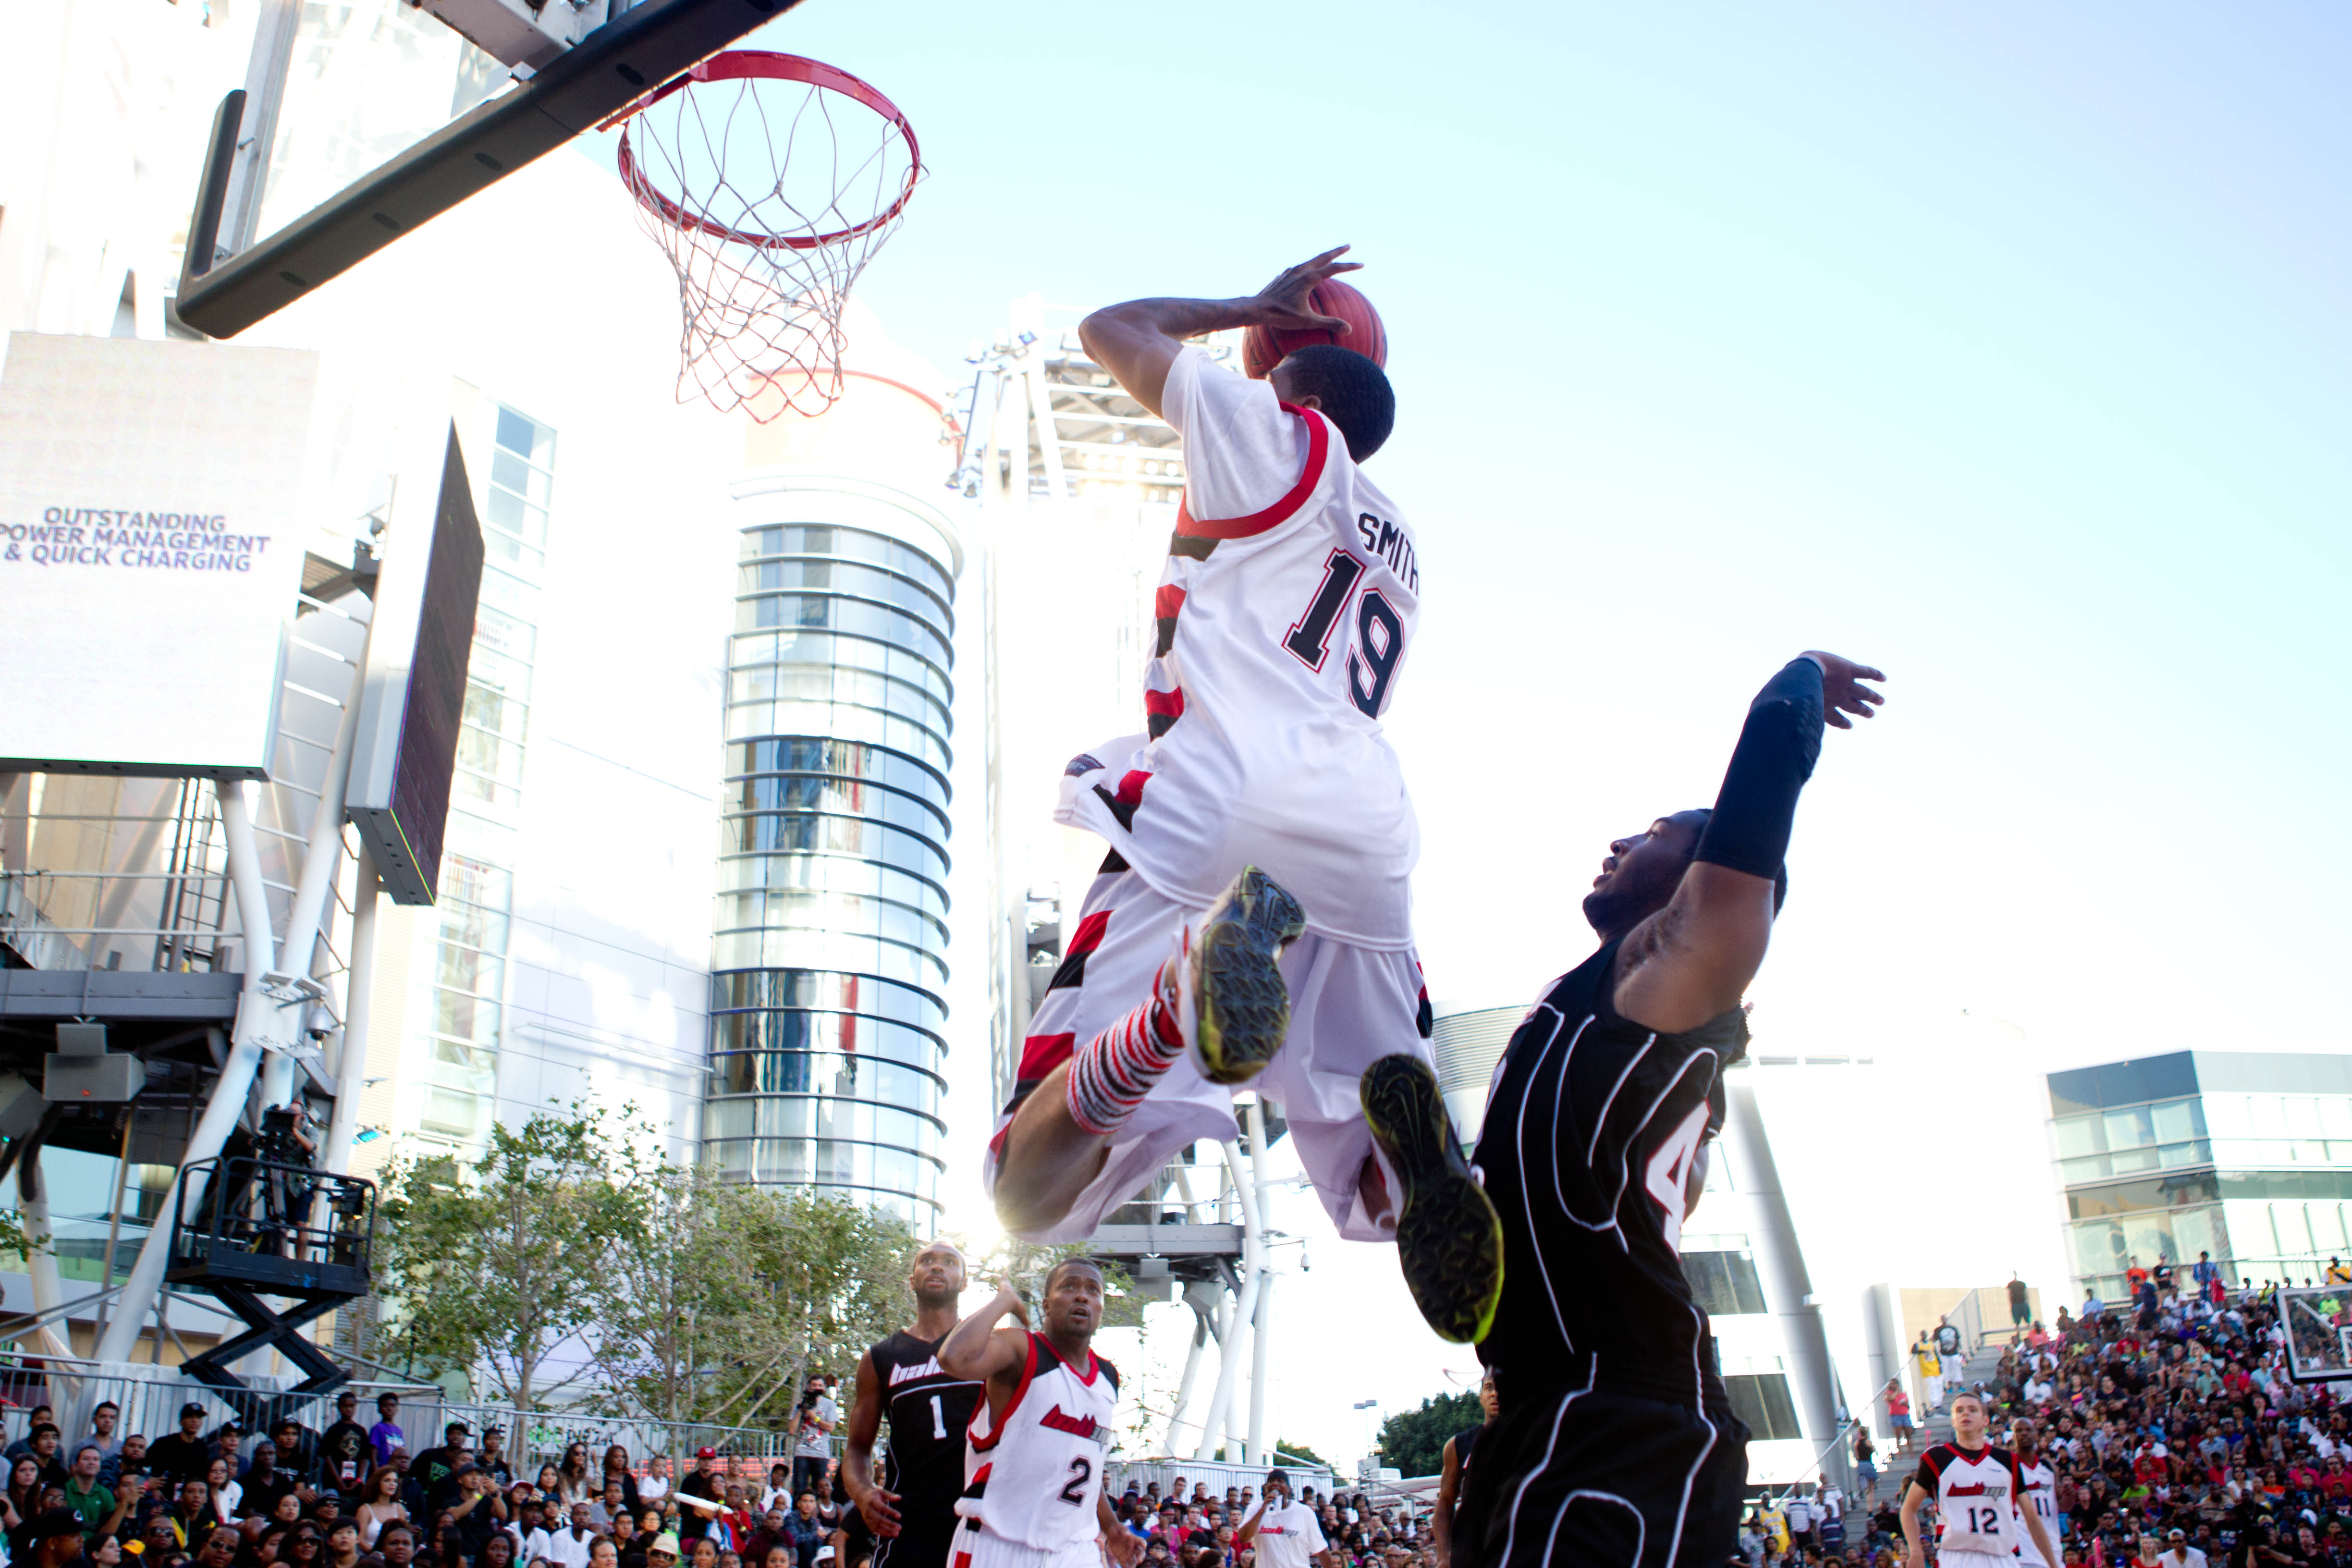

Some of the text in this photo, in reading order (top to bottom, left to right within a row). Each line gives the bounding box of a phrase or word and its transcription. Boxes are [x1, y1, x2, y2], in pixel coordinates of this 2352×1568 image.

[44, 507, 225, 533] OUTSTANDING
[4, 542, 251, 572] & QUICK CHARGING
[93, 527, 271, 553] MANAGEMENT
[1358, 513, 1418, 596] SMITH
[1281, 547, 1405, 721] 19
[1645, 1098, 1712, 1262] 4
[930, 1395, 947, 1440] 1
[1058, 1454, 1091, 1507] 2
[1968, 1507, 1999, 1535] 12
[2034, 1496, 2051, 1518] 11
